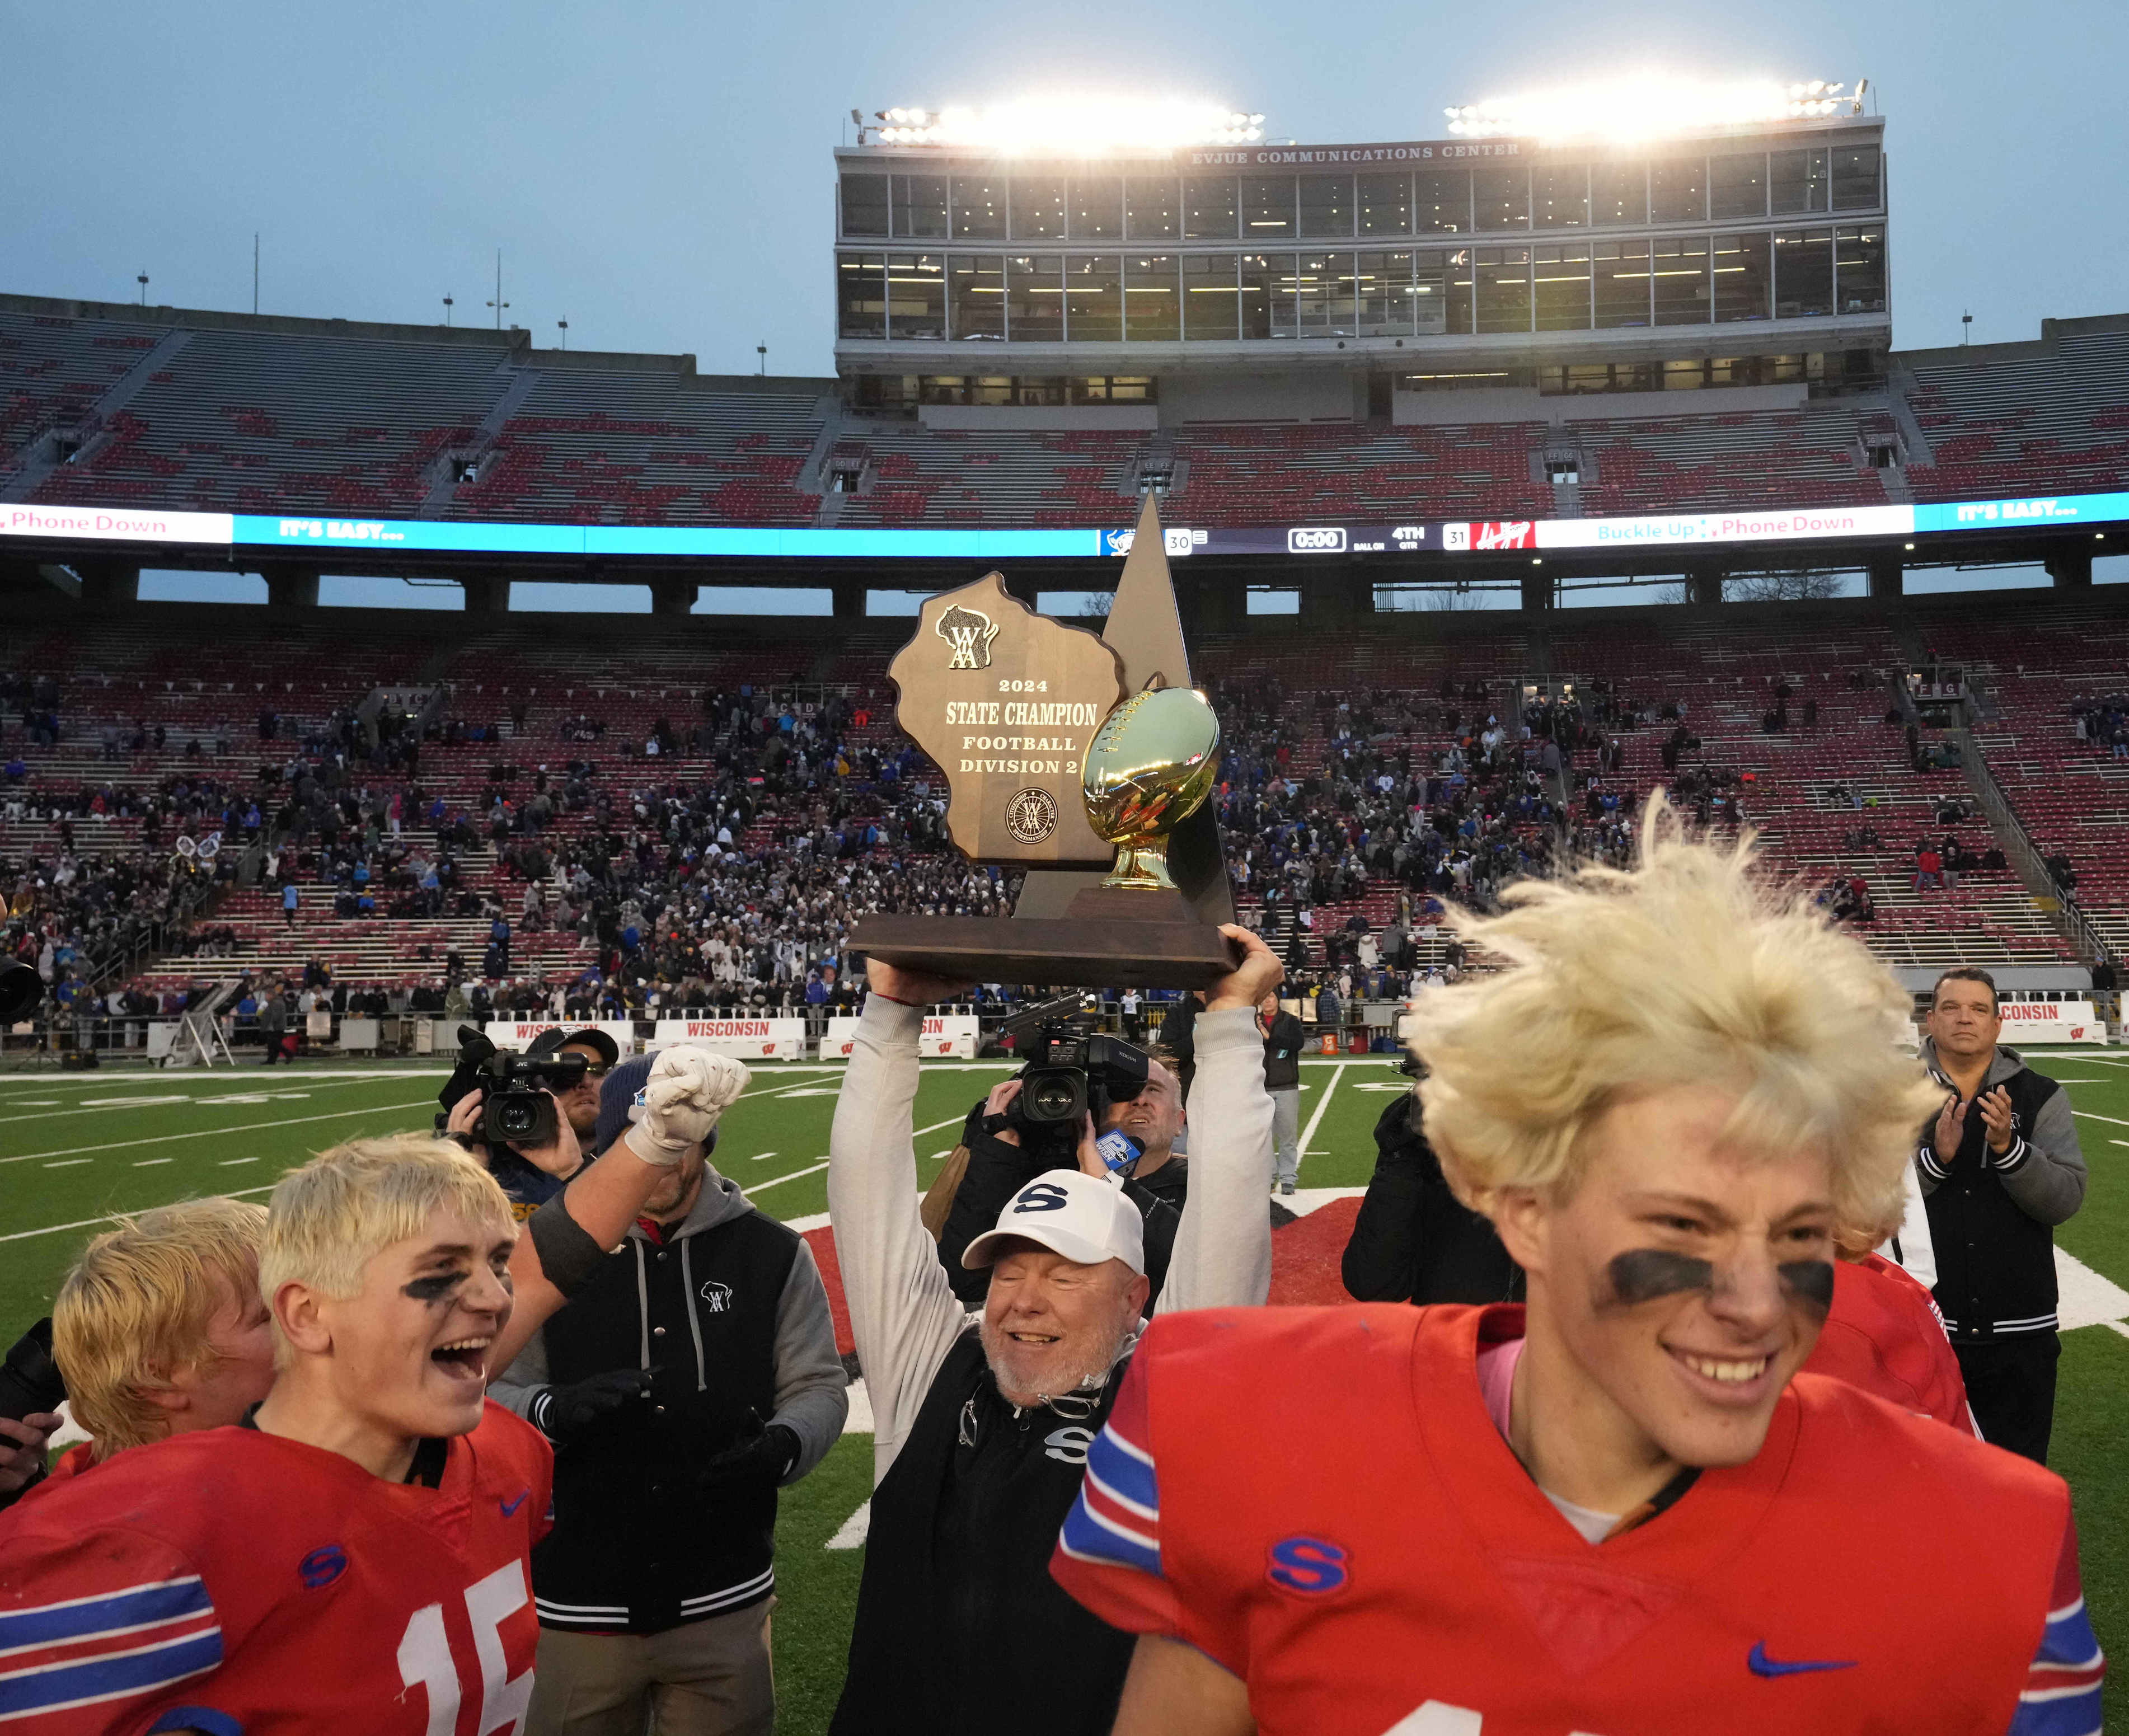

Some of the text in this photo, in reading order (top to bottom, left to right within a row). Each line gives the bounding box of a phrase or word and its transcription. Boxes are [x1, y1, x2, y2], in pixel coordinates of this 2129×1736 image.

[1192, 143, 1519, 165] EVJUE COMMUNICATIONS CENTER
[1957, 504, 1999, 521] IT'S
[12, 512, 166, 533] Phone Down
[279, 520, 323, 537] IT'S
[1598, 516, 1854, 539] Buckle Up Phone Down
[1295, 532, 1338, 547] 0:00
[1392, 527, 1425, 540] 4TH
[1450, 532, 1464, 543] 31
[1170, 537, 1189, 548] 30
[1353, 542, 1371, 551] BALL
[998, 679, 1048, 692] 2024
[1920, 684, 1928, 695] F
[1945, 683, 1954, 693] G
[780, 702, 788, 712] C
[805, 702, 814, 712] D
[946, 701, 1098, 726] STATE CHAMPION
[962, 736, 1076, 751] FOOTBALL
[959, 759, 1077, 774] DIVISION 2
[1009, 792, 1028, 818] CITIZENSHIP
[1039, 794, 1055, 819] CHARACTER
[1012, 829, 1048, 842] SPORTSMANSHIP
[2001, 1005, 2058, 1020] CONSIN
[687, 1021, 770, 1036] WISCONSIN
[1095, 1142, 1114, 1161] WISN
[1116, 1151, 1128, 1162] abc
[1013, 1183, 1068, 1214] S
[1044, 1426, 1096, 1465] S
[302, 1545, 347, 1588] S
[1270, 1538, 1343, 1591] S
[396, 1557, 535, 1736] 15
